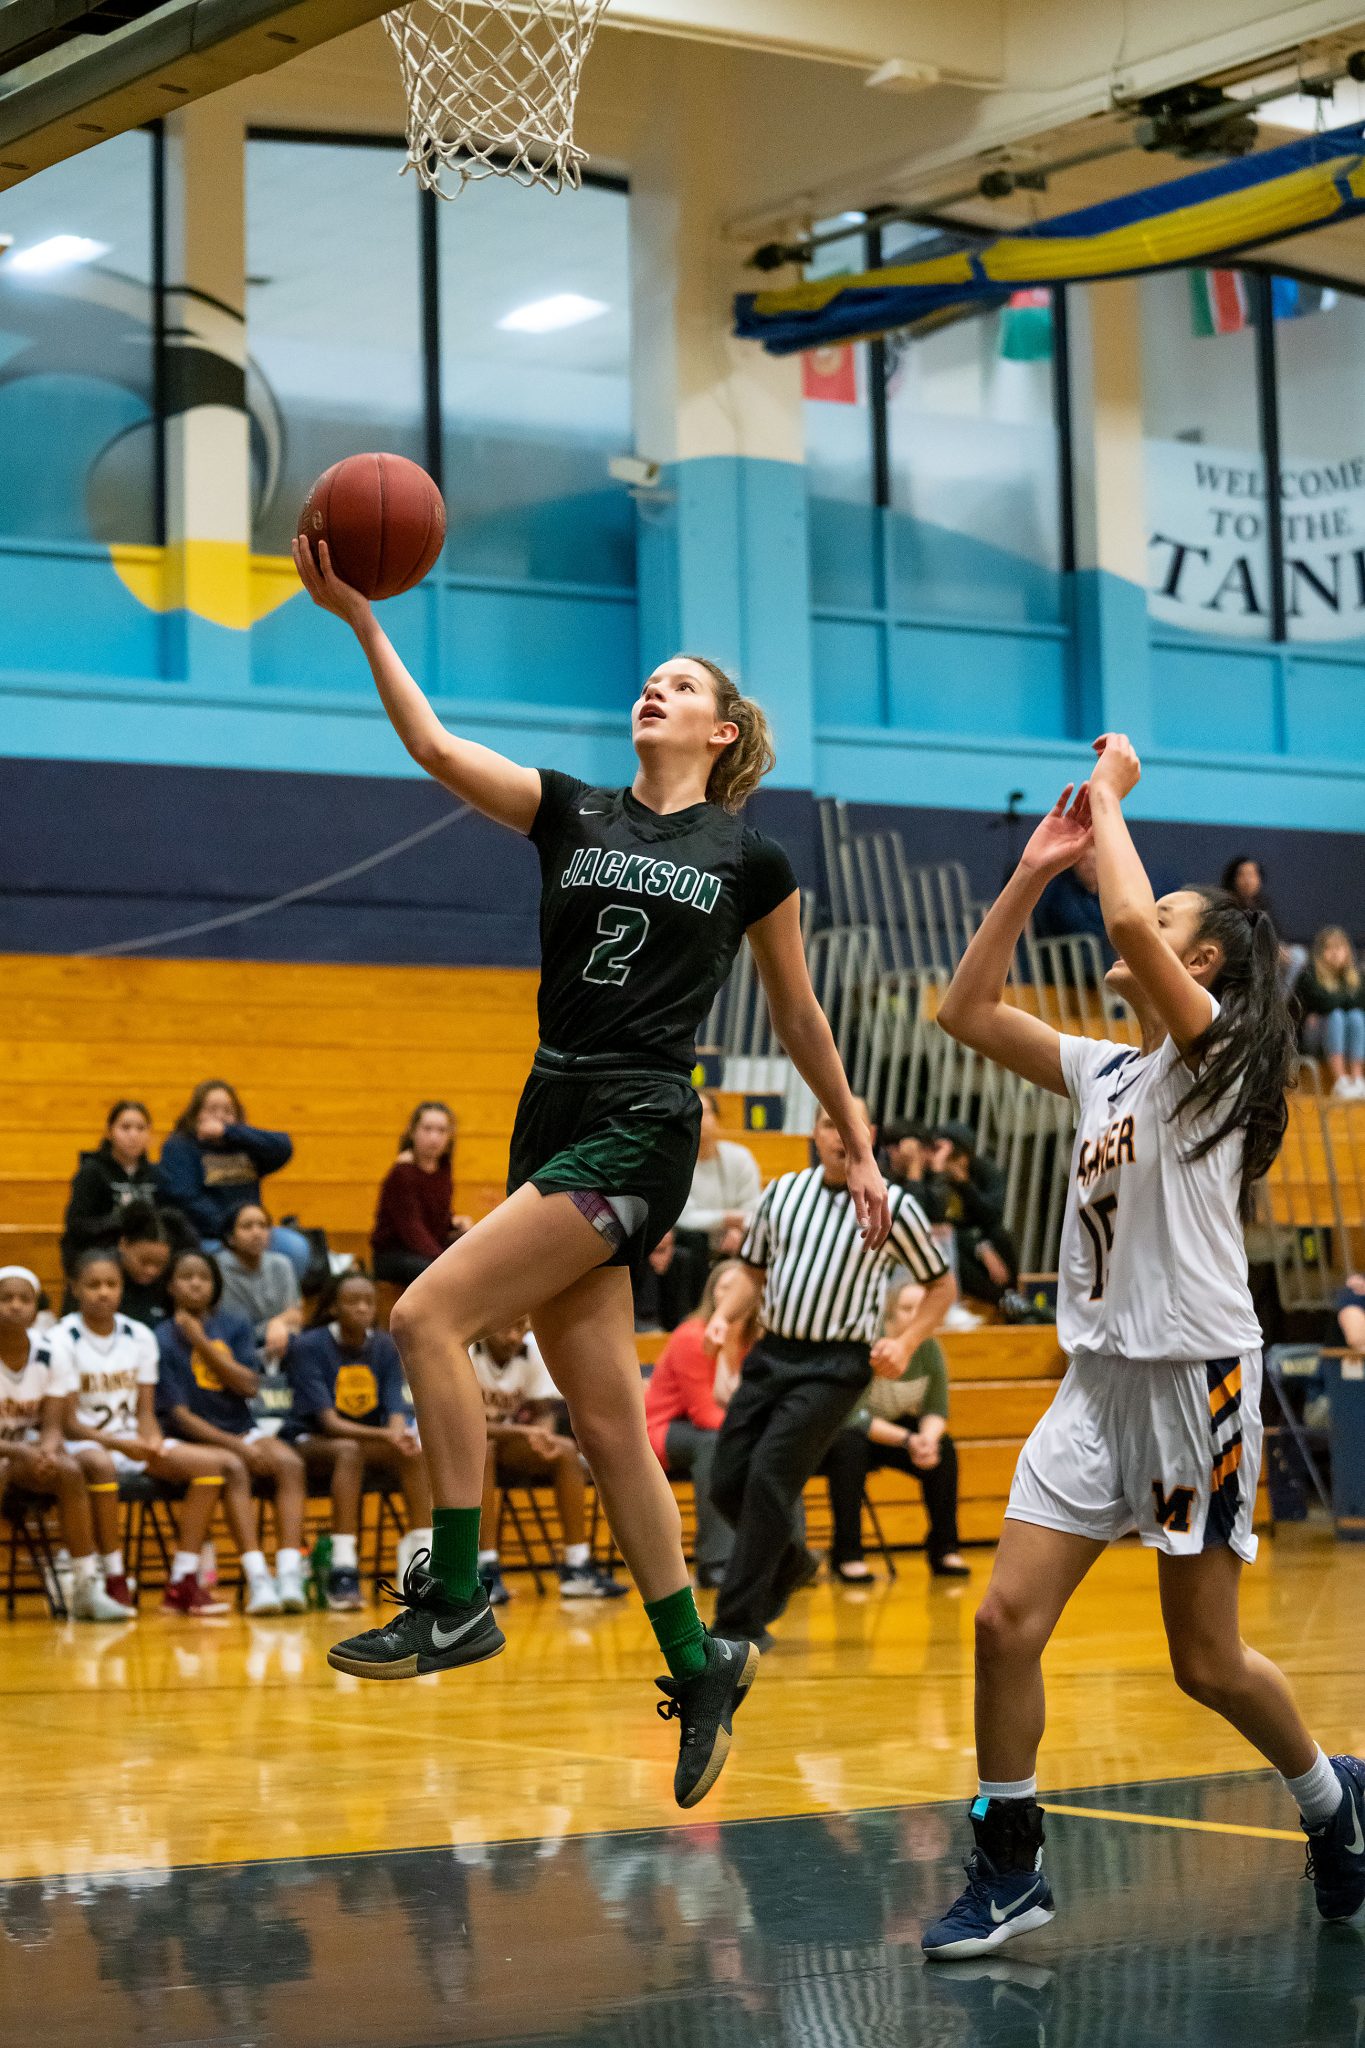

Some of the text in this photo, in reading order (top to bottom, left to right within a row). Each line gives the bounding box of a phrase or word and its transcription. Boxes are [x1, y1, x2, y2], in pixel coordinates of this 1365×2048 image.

[1209, 506, 1354, 543] TO THE
[561, 847, 722, 914] JACKSON
[582, 903, 651, 987] 2
[1151, 1479, 1198, 1533] M
